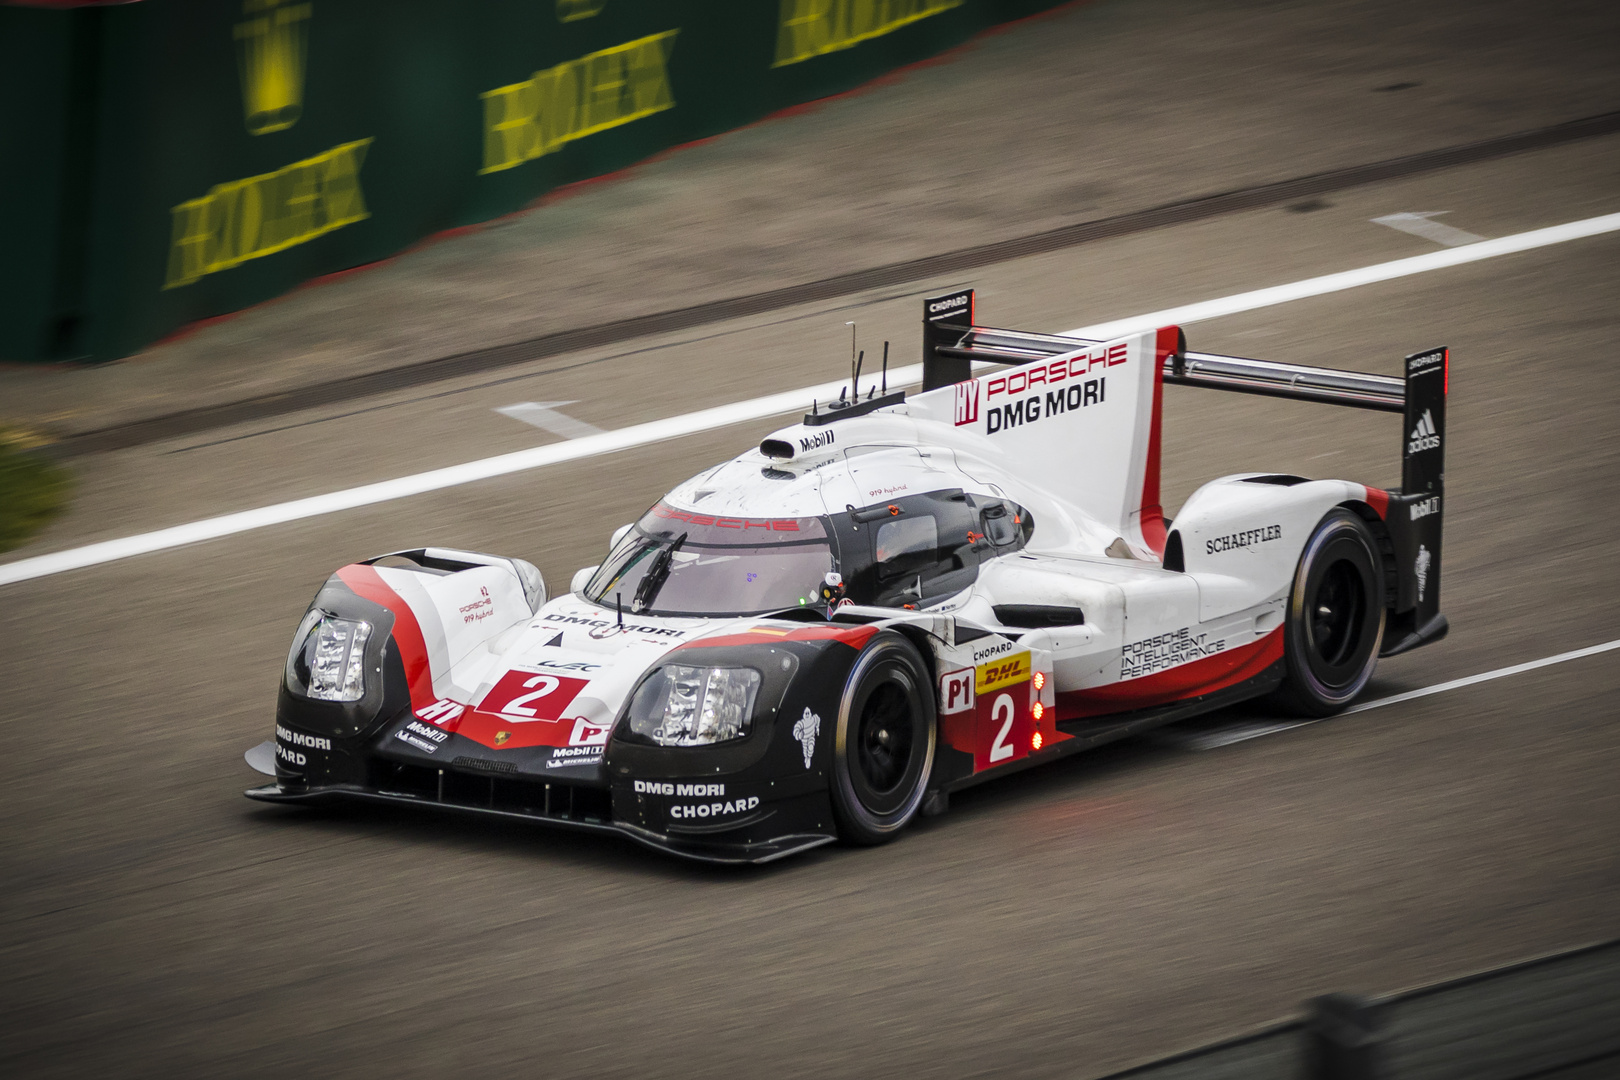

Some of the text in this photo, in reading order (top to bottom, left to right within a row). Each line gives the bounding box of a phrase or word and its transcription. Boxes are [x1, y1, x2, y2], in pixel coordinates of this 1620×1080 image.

[929, 295, 968, 313] CHOPARD
[987, 343, 1128, 401] PORSCHE
[986, 376, 1107, 435] DMG MORI
[650, 504, 800, 531] PORSCHE
[1206, 524, 1282, 555] SCHAEFFLER
[459, 597, 492, 613] PORSCHE
[544, 614, 686, 637] DMG MORI
[973, 642, 1013, 661] CHOPARD
[1121, 633, 1208, 668] INTELLIGENT
[1122, 627, 1189, 656] PORSCHE
[984, 660, 1022, 685] DHL
[1120, 640, 1226, 680] PERFORMANCE
[501, 675, 560, 717] 2
[948, 675, 970, 709] P1
[293, 731, 331, 751] MORI
[579, 726, 611, 742] P
[989, 693, 1015, 763] 2
[634, 780, 725, 797] DMG MORI
[670, 796, 760, 818] CHOPARD
